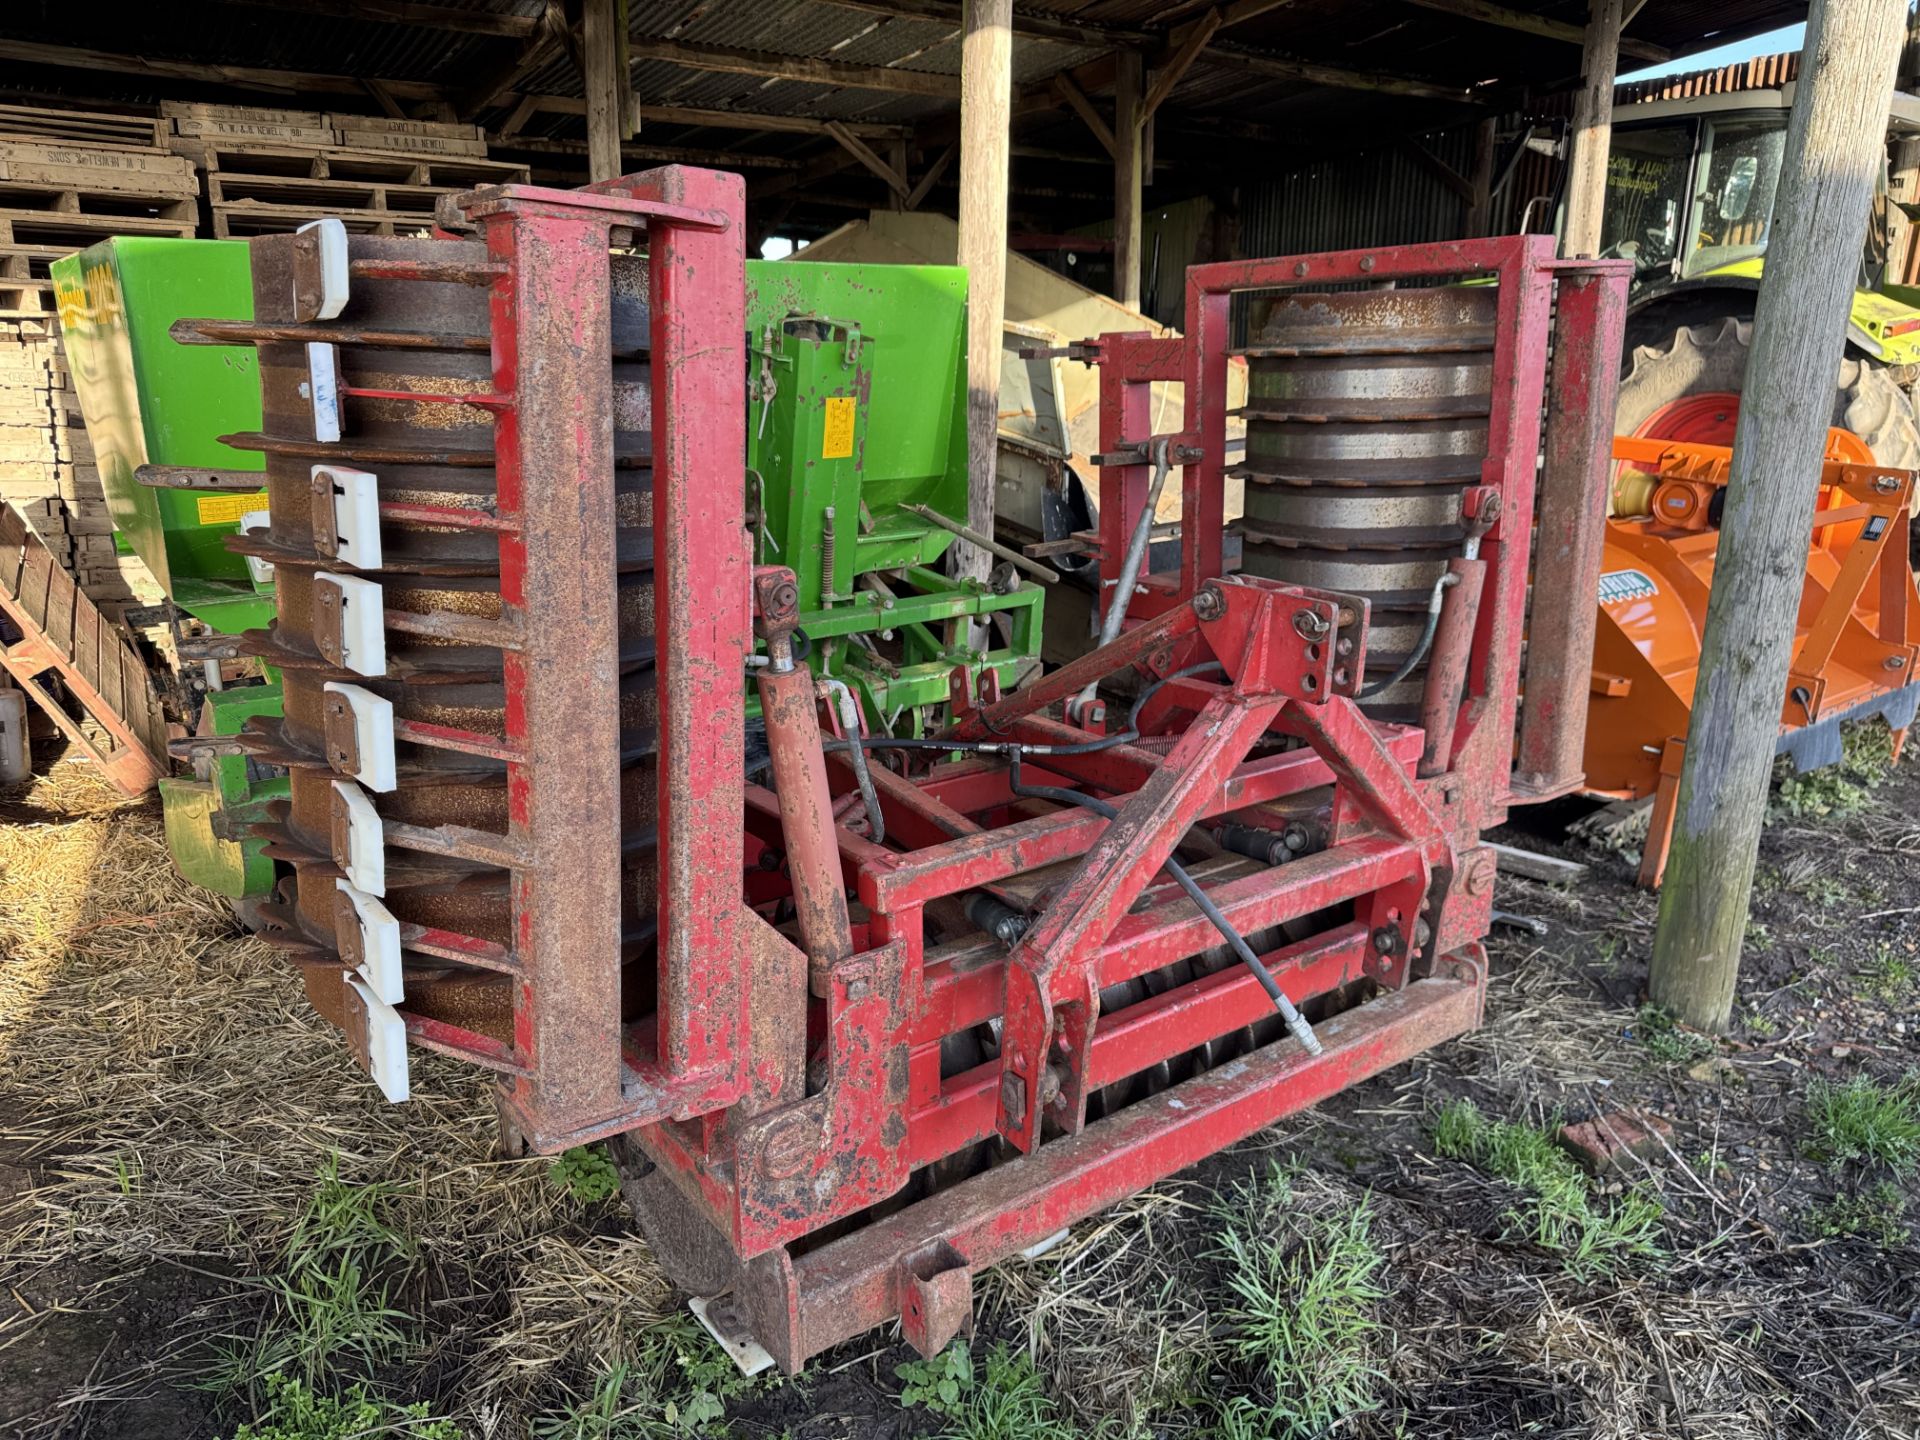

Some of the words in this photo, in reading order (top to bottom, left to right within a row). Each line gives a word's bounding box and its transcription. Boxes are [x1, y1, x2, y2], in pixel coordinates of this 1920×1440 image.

[257, 125, 284, 137] NEWELL
[421, 138, 446, 150] NEWELL
[48, 150, 71, 164] SONS
[86, 153, 120, 168] NEWELL
